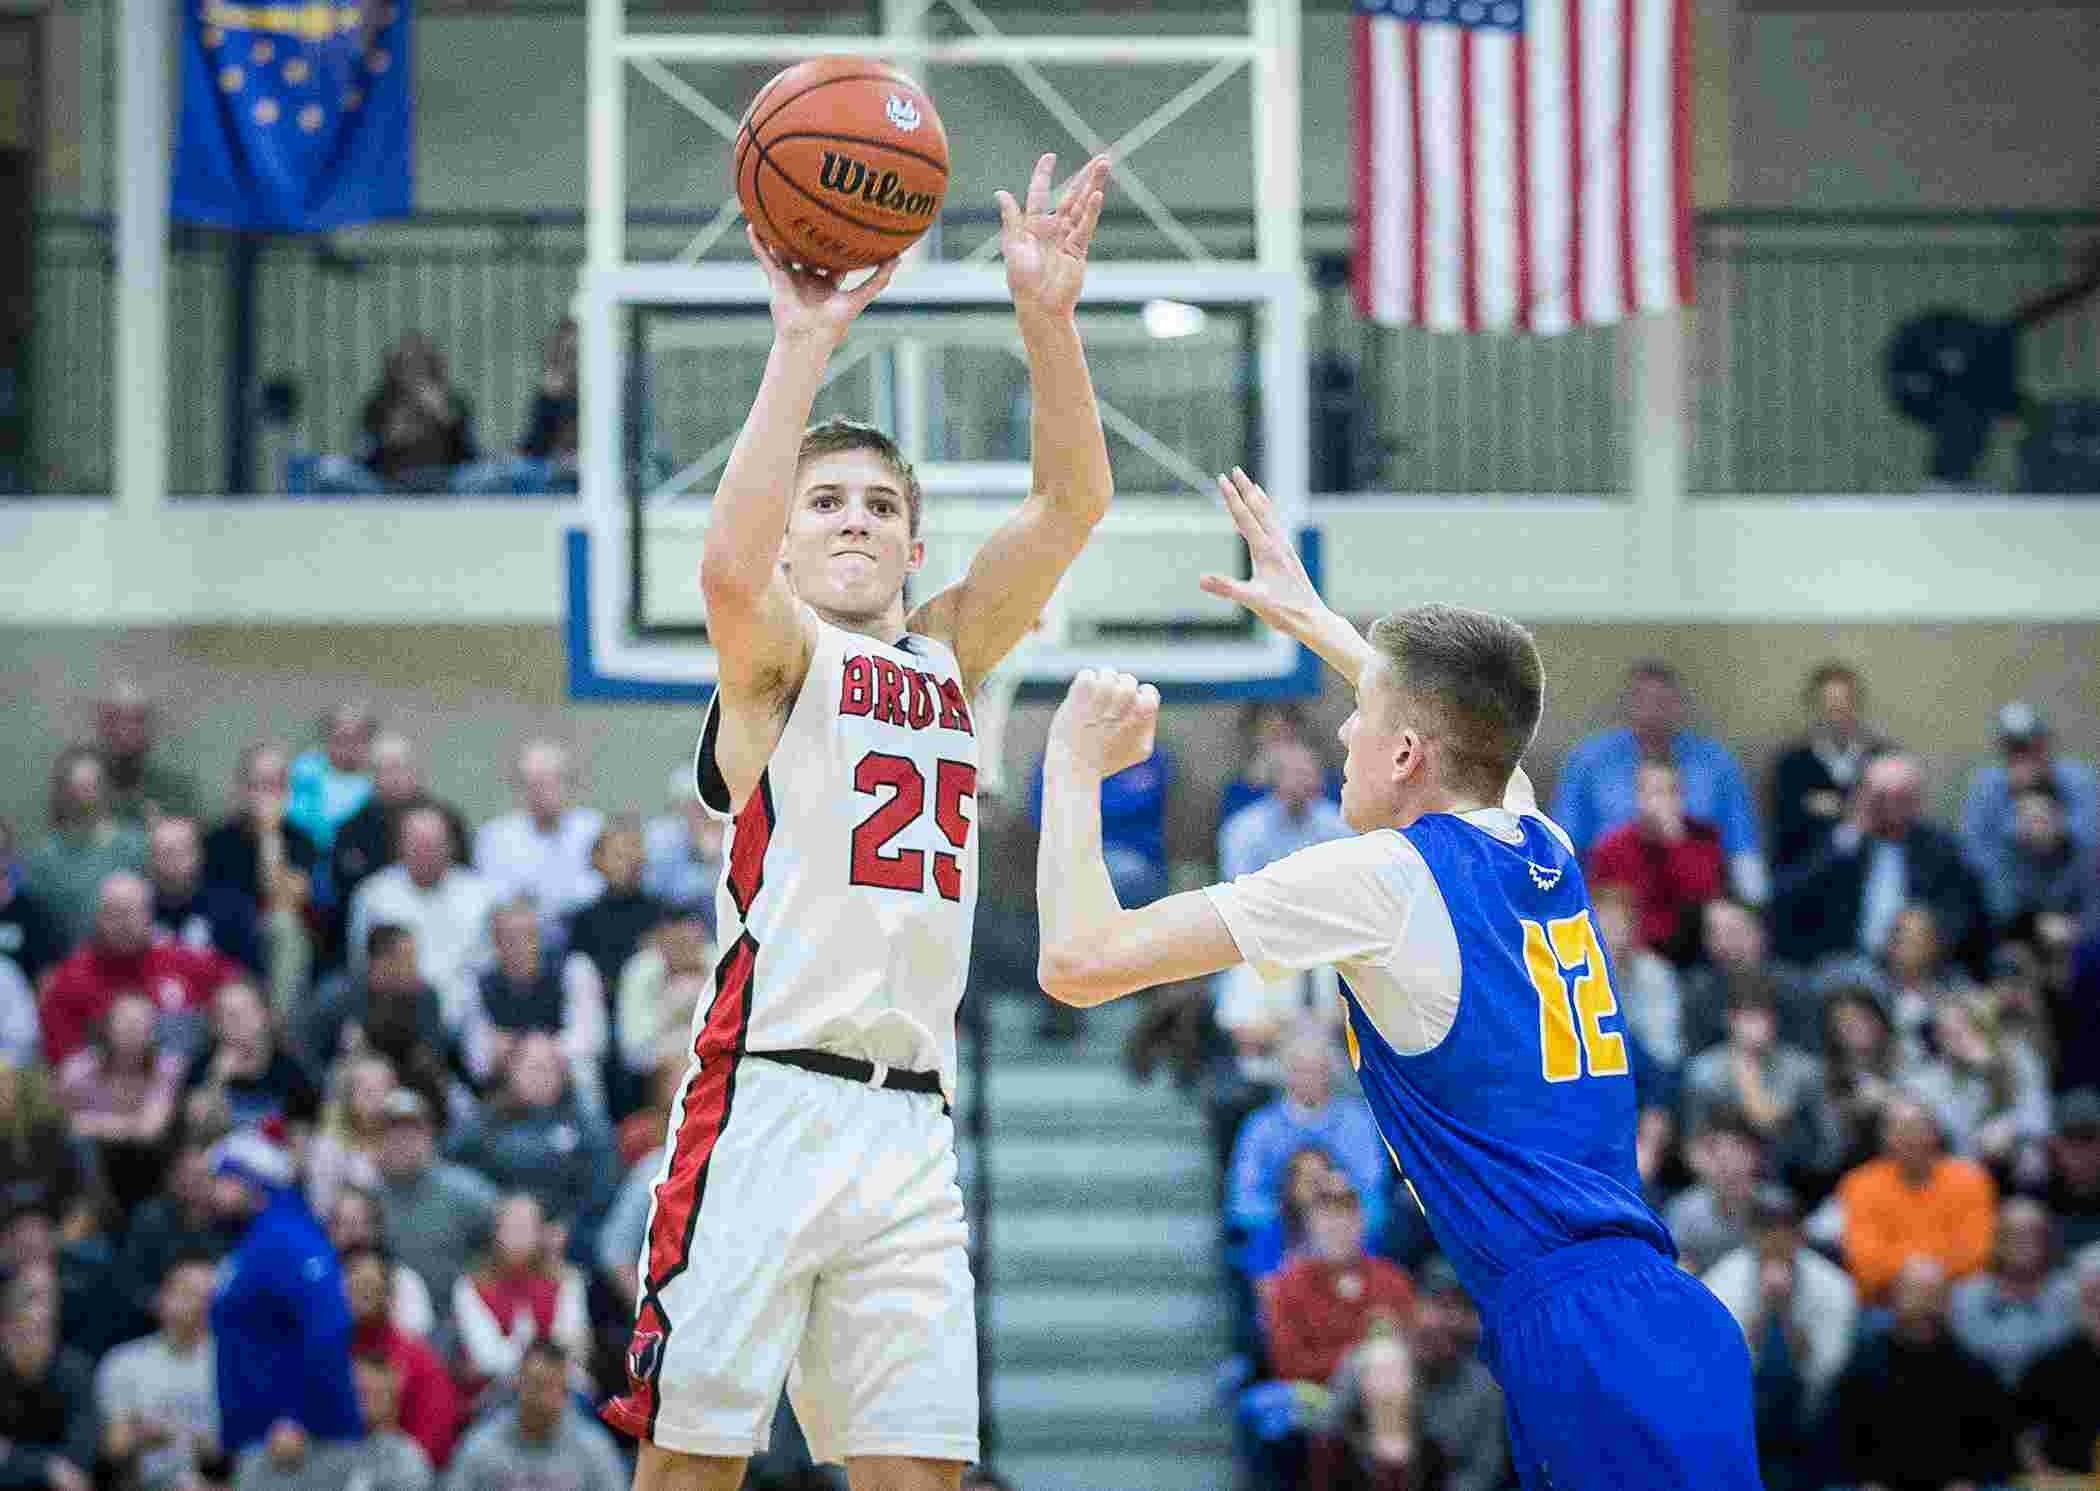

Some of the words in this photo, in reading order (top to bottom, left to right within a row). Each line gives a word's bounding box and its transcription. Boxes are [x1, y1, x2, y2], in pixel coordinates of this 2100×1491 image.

[820, 151, 936, 216] Wilson
[849, 751, 977, 902] 25
[1519, 908, 1629, 1083] 12
